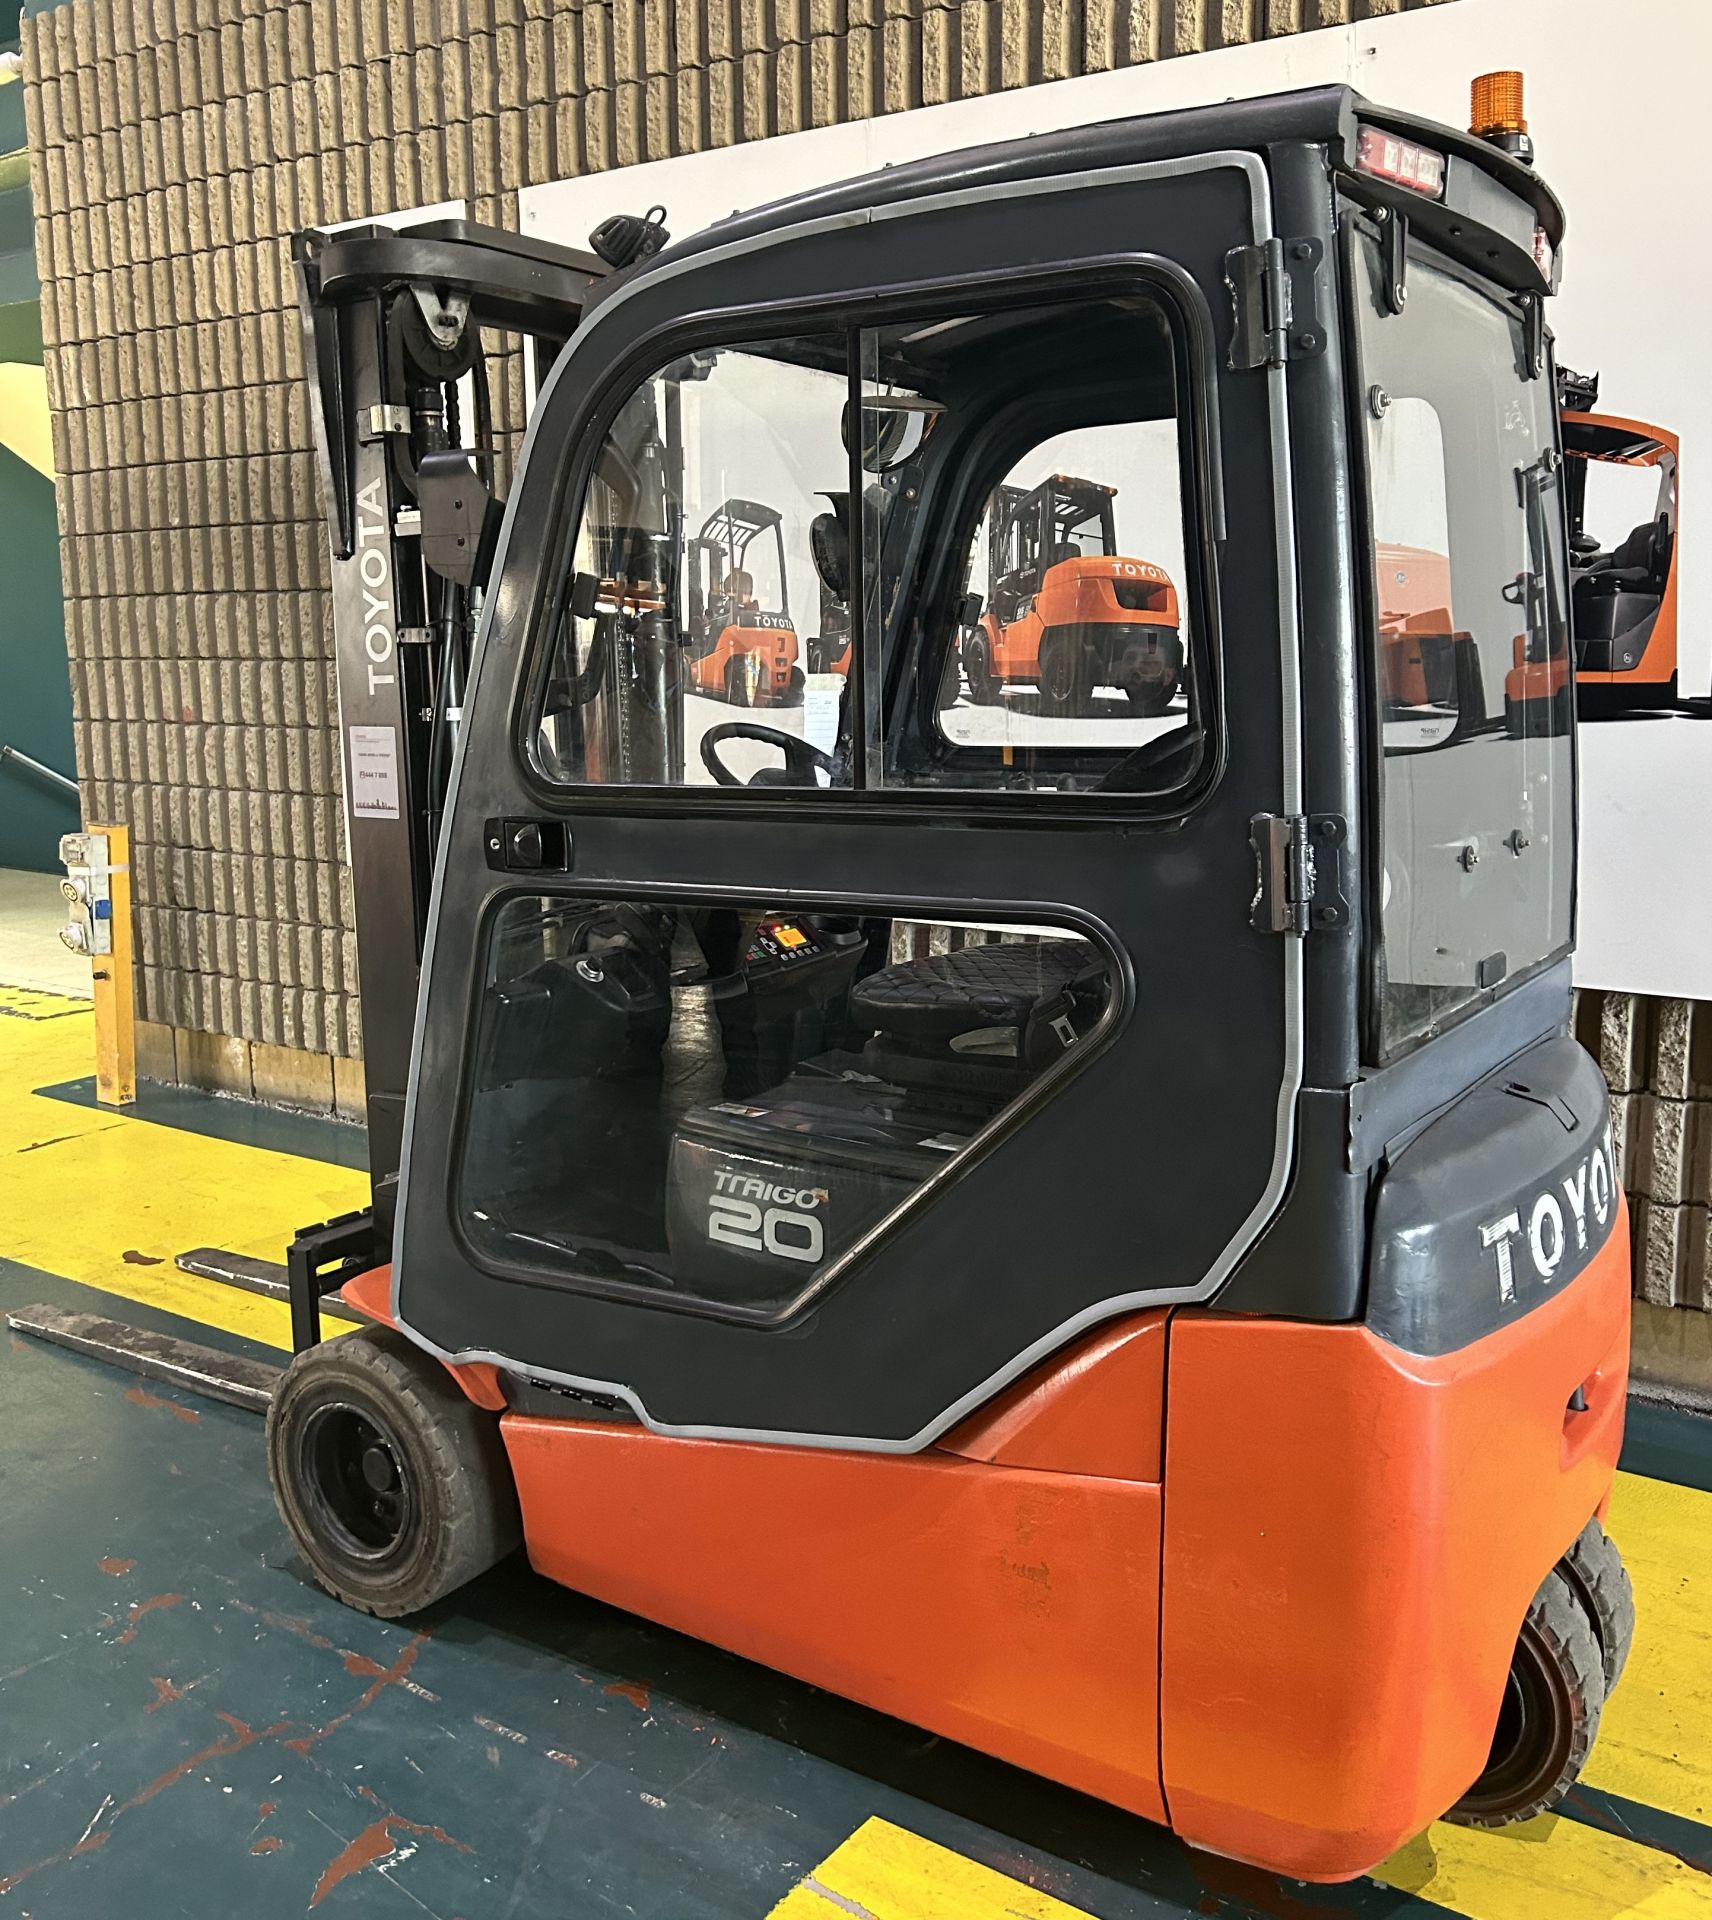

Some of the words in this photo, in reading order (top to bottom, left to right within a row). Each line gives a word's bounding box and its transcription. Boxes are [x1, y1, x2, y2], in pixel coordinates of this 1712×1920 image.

[356, 477, 395, 695] TOYOTA
[713, 1170, 820, 1209] TRAIGO
[709, 1195, 823, 1262] 20
